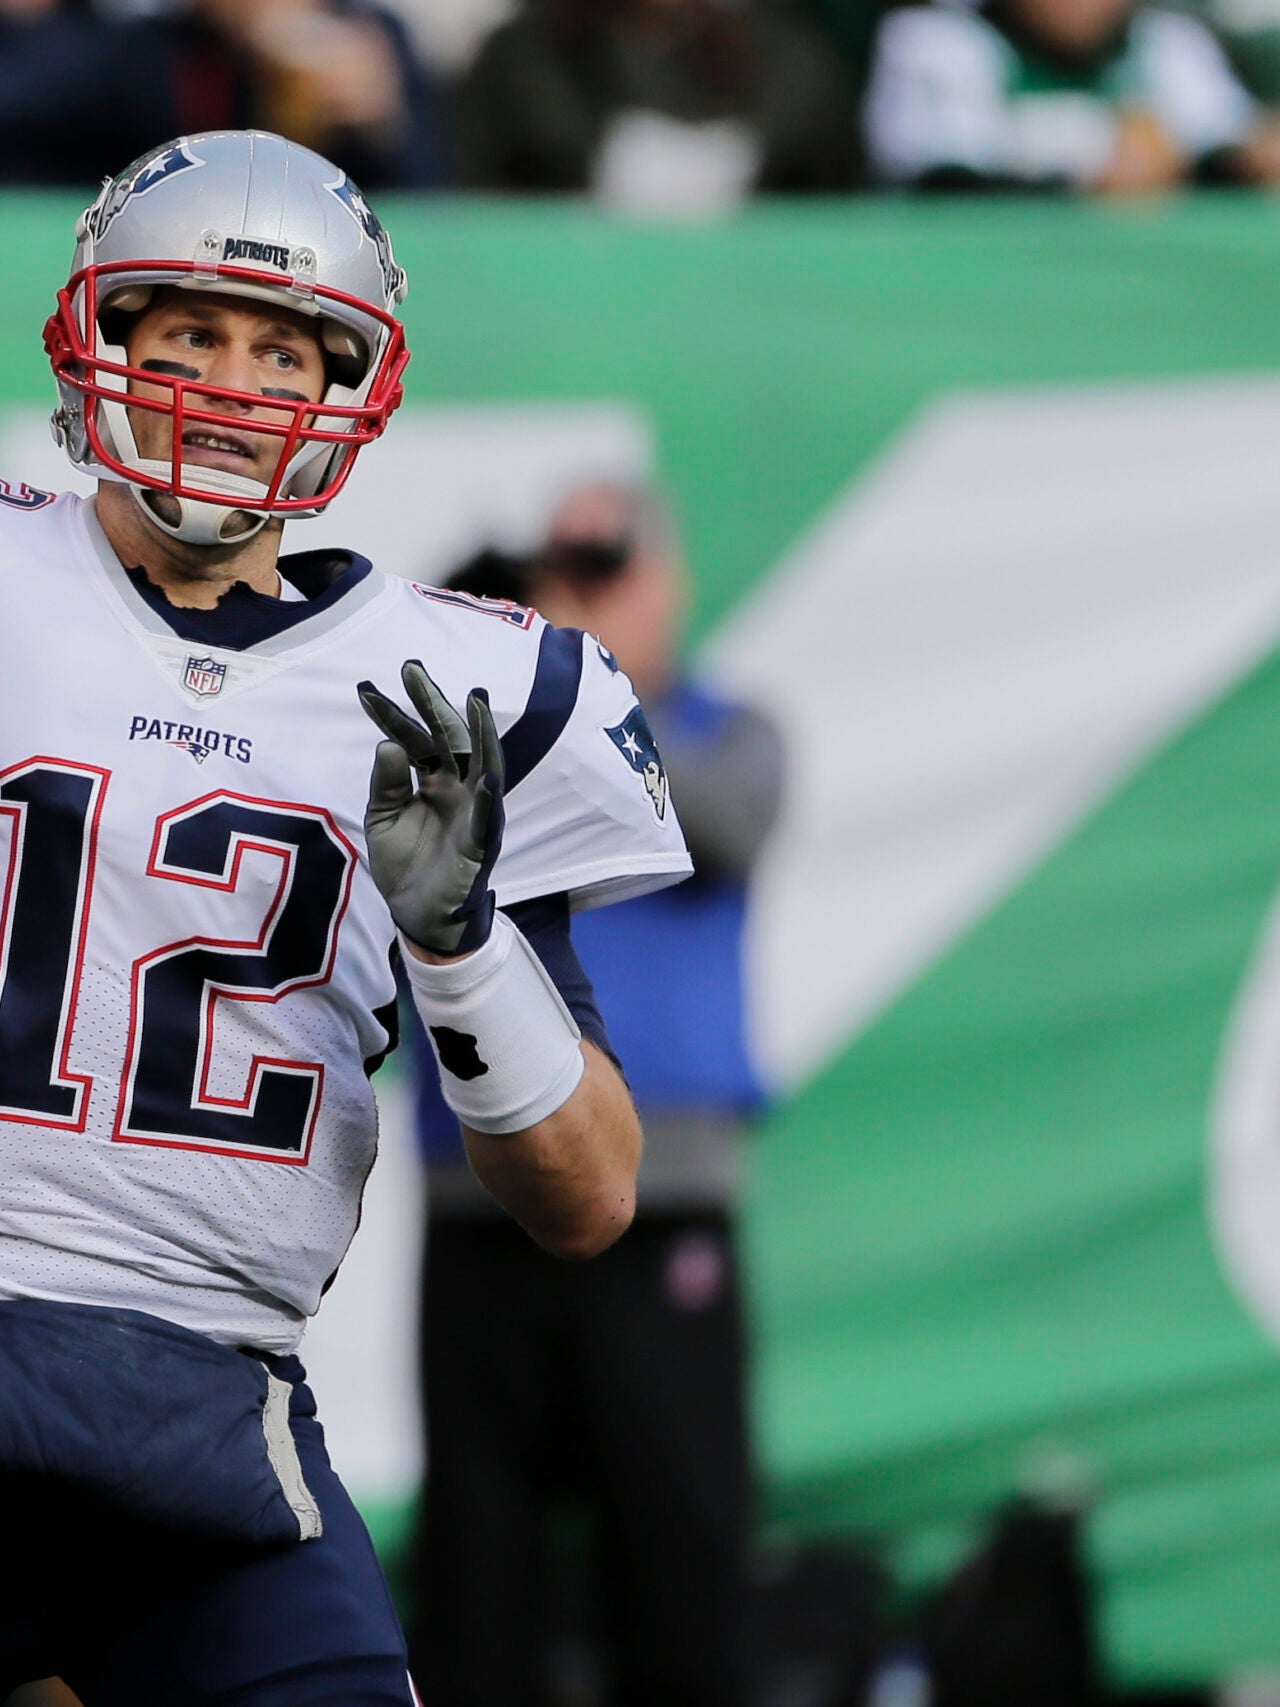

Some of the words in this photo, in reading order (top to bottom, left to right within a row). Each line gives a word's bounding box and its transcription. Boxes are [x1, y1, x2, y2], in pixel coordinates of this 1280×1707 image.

[223, 237, 289, 271] PATRIOTS
[188, 670, 218, 692] NFL
[129, 716, 253, 764] PATRIOTS
